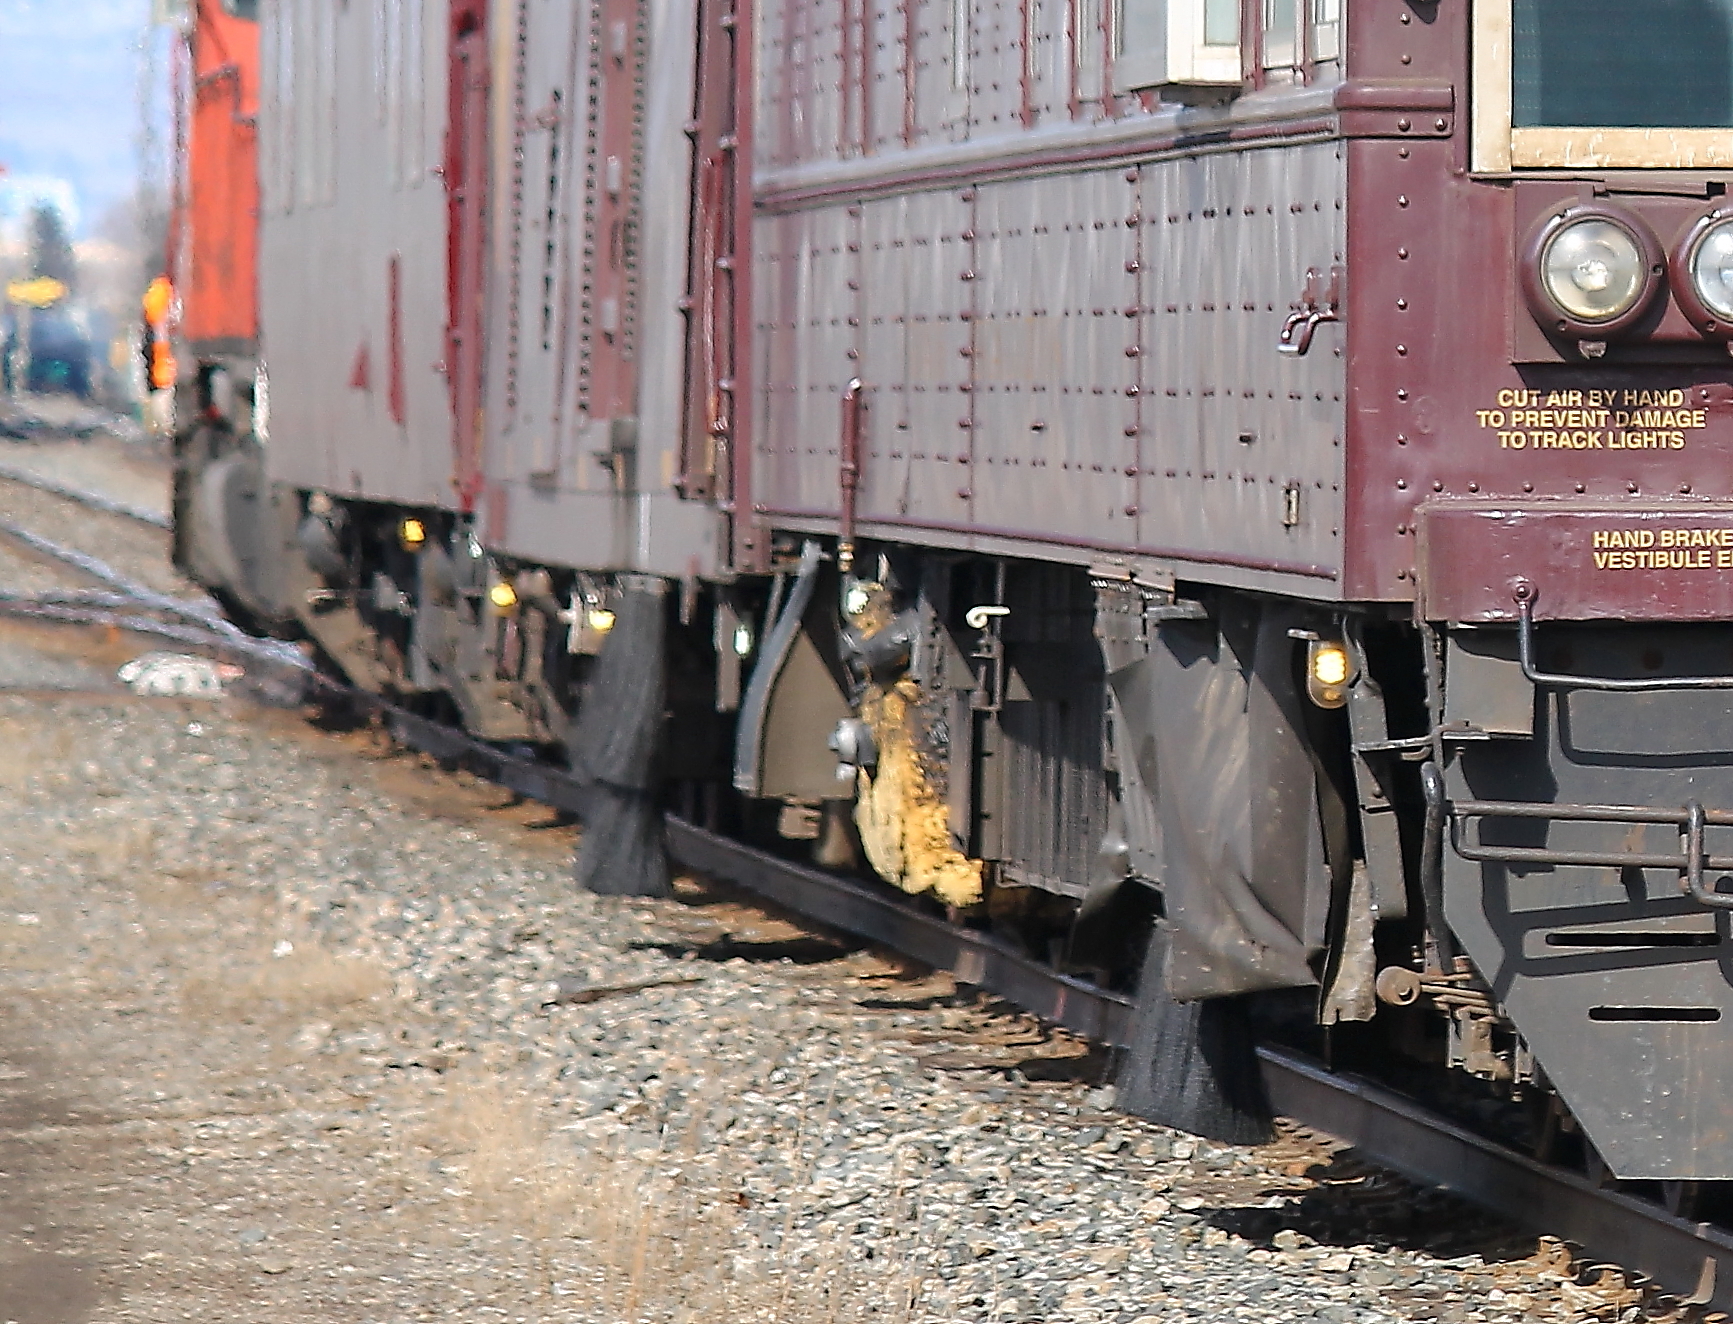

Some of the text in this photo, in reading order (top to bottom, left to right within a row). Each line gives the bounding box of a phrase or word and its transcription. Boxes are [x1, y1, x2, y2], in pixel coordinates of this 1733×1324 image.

[1497, 389, 1684, 407] CUT AIR BY HAND
[1476, 410, 1706, 428] TO PREVENT DAMAGE
[1497, 431, 1685, 449] TO TRACK LIGHTS
[1593, 530, 1654, 548] HAND
[1660, 529, 1733, 547] BRAKE
[1593, 551, 1711, 569] VESTIBULE
